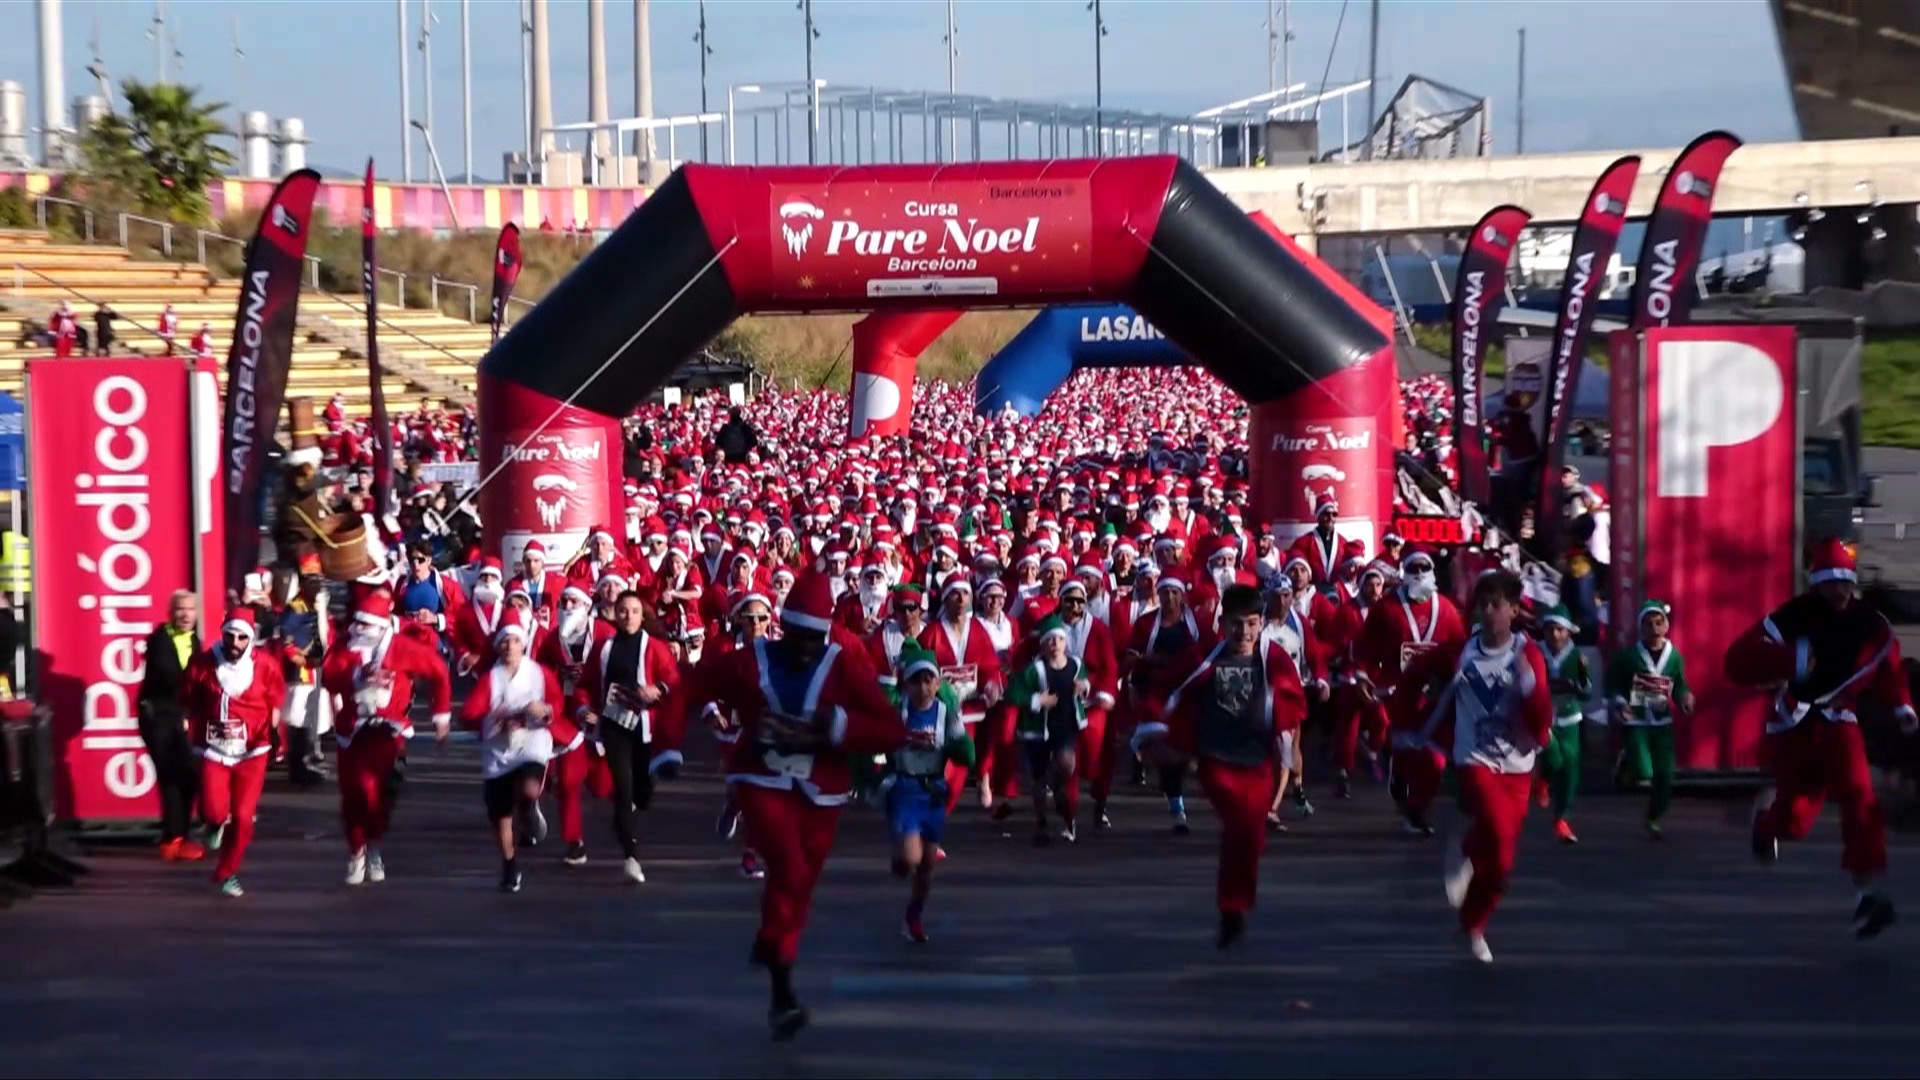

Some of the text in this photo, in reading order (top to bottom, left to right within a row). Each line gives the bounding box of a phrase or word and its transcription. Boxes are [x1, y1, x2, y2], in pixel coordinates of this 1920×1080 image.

[904, 201, 958, 216] Cursa
[990, 186, 1062, 199] Barcelona
[824, 217, 1041, 256] Pare Noel
[887, 257, 977, 272] Barcelona
[1648, 239, 1679, 327] ONA
[1463, 271, 1485, 427] BARCELONA
[230, 269, 270, 495] BARCELONA
[1657, 341, 1784, 496] P
[553, 440, 600, 461] Noel
[1271, 430, 1370, 450] Pare Noel
[75, 375, 159, 799] elPeriódico
